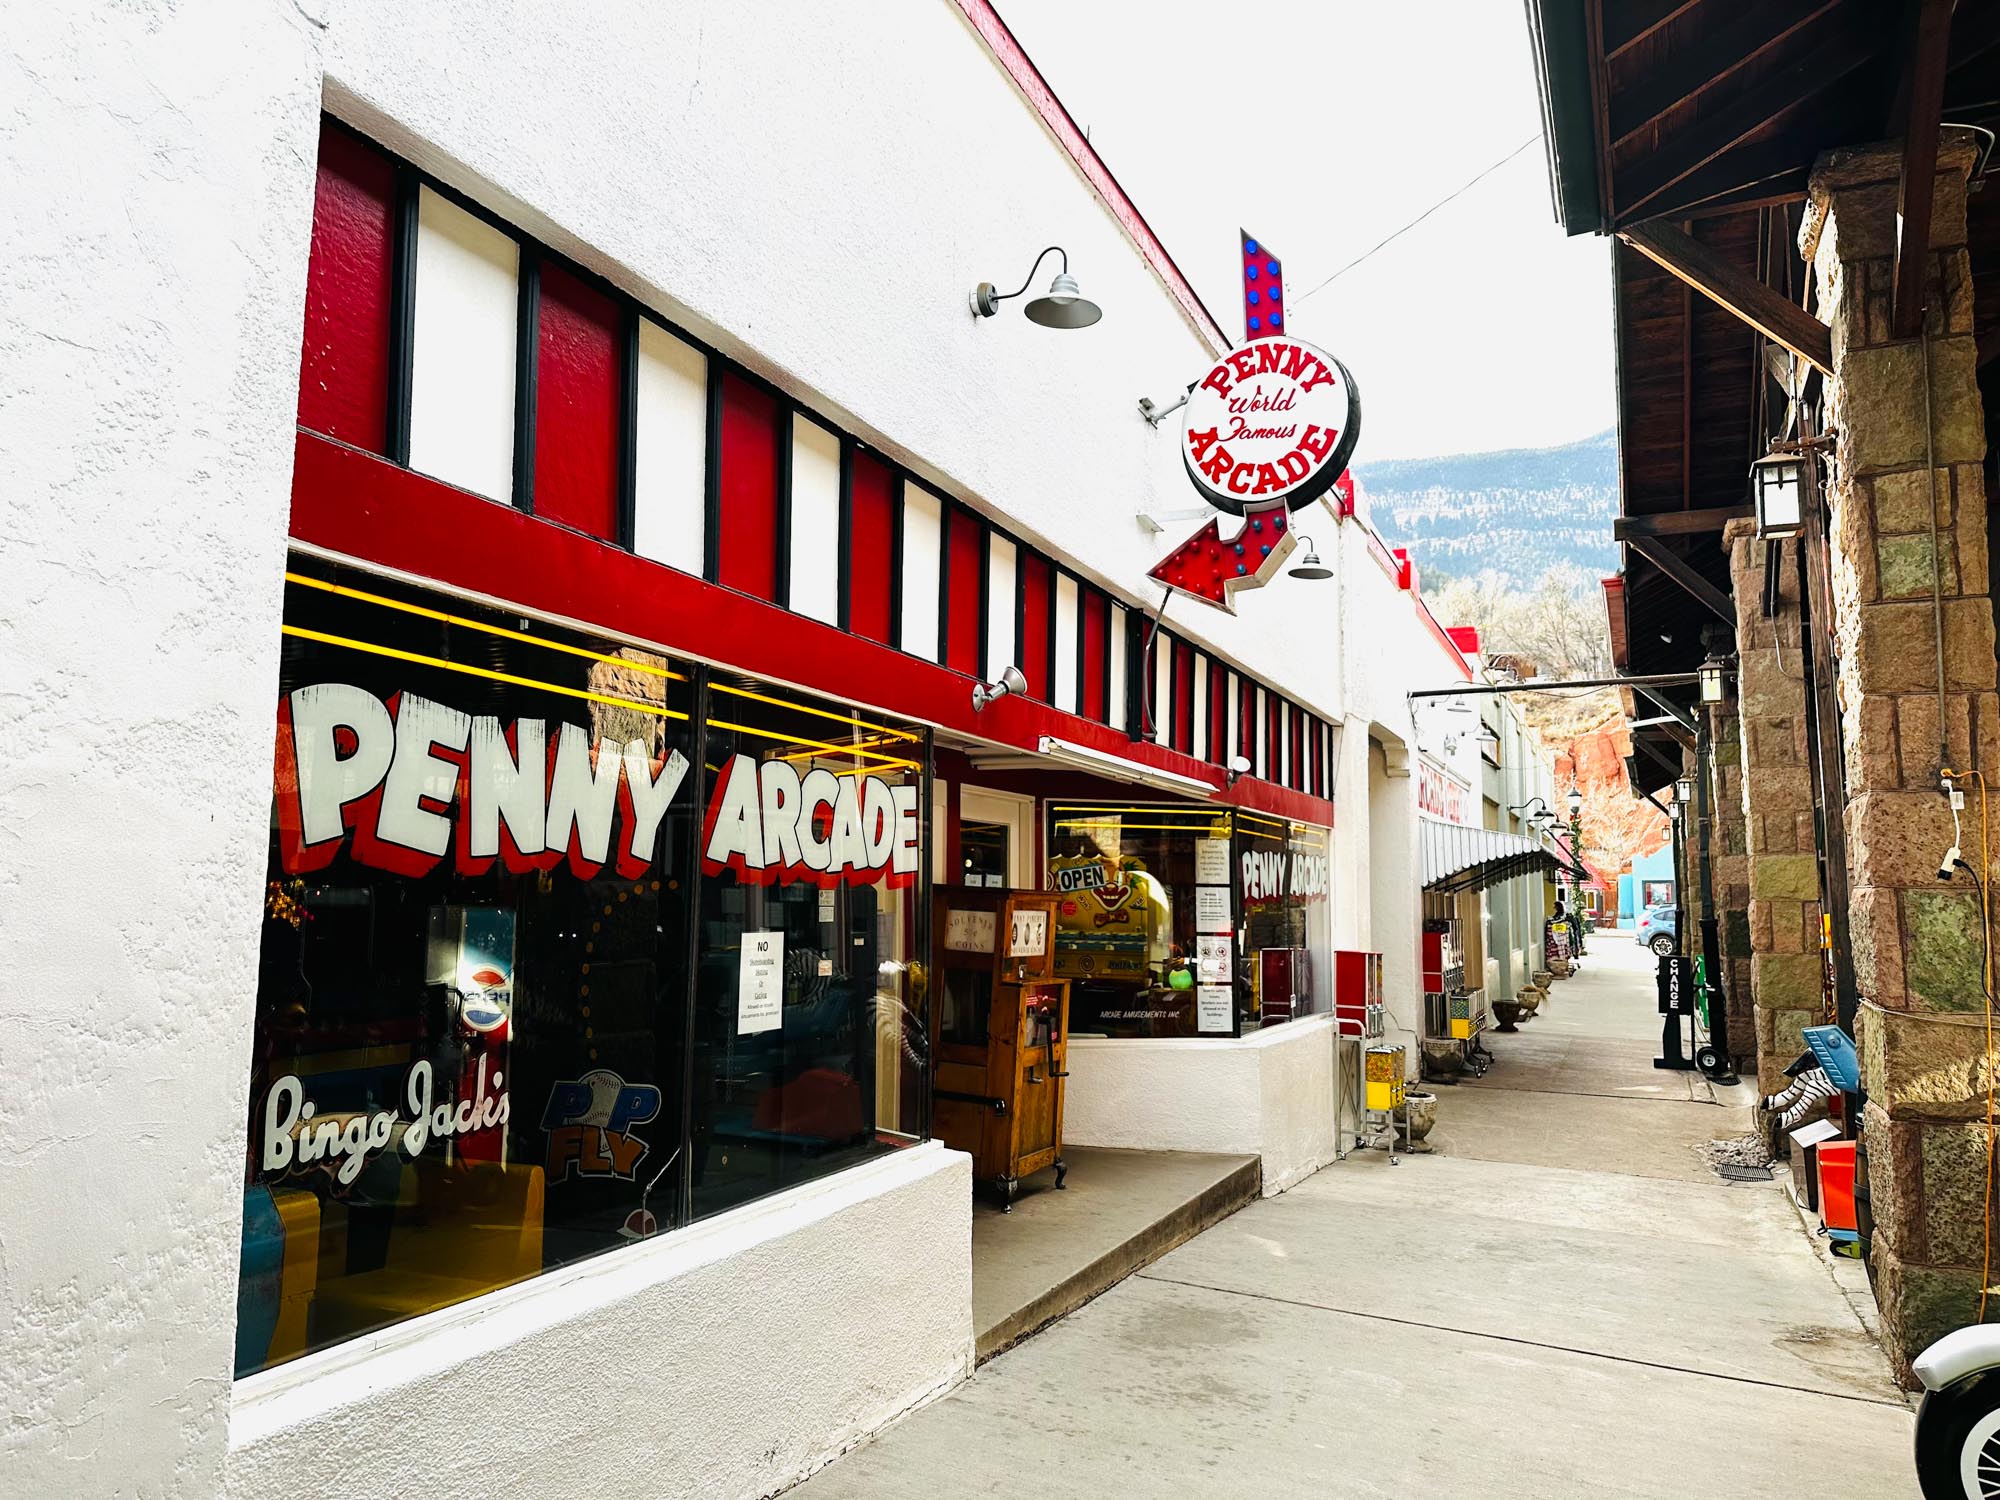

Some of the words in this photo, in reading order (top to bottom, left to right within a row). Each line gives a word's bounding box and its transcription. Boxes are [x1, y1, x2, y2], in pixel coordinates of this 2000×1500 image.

[1201, 342, 1336, 400] PENNY
[1228, 384, 1296, 414] World
[1218, 416, 1298, 442] Famous
[1188, 423, 1338, 495] ARCADE
[284, 683, 689, 864] PENNY
[706, 754, 919, 875] ARCADE
[1060, 866, 1105, 890] OPEN
[1242, 850, 1287, 900] PENNY
[1289, 853, 1327, 897] ARCADE
[757, 941, 769, 952] NO
[1669, 959, 1679, 1009] CHANGE
[1100, 1010, 1122, 1019] ARCADE
[1123, 1010, 1166, 1019] AMUSEMENTS
[262, 1073, 399, 1185] Bingo
[403, 1051, 511, 1158] Jack's
[546, 1125, 651, 1182] FLY
